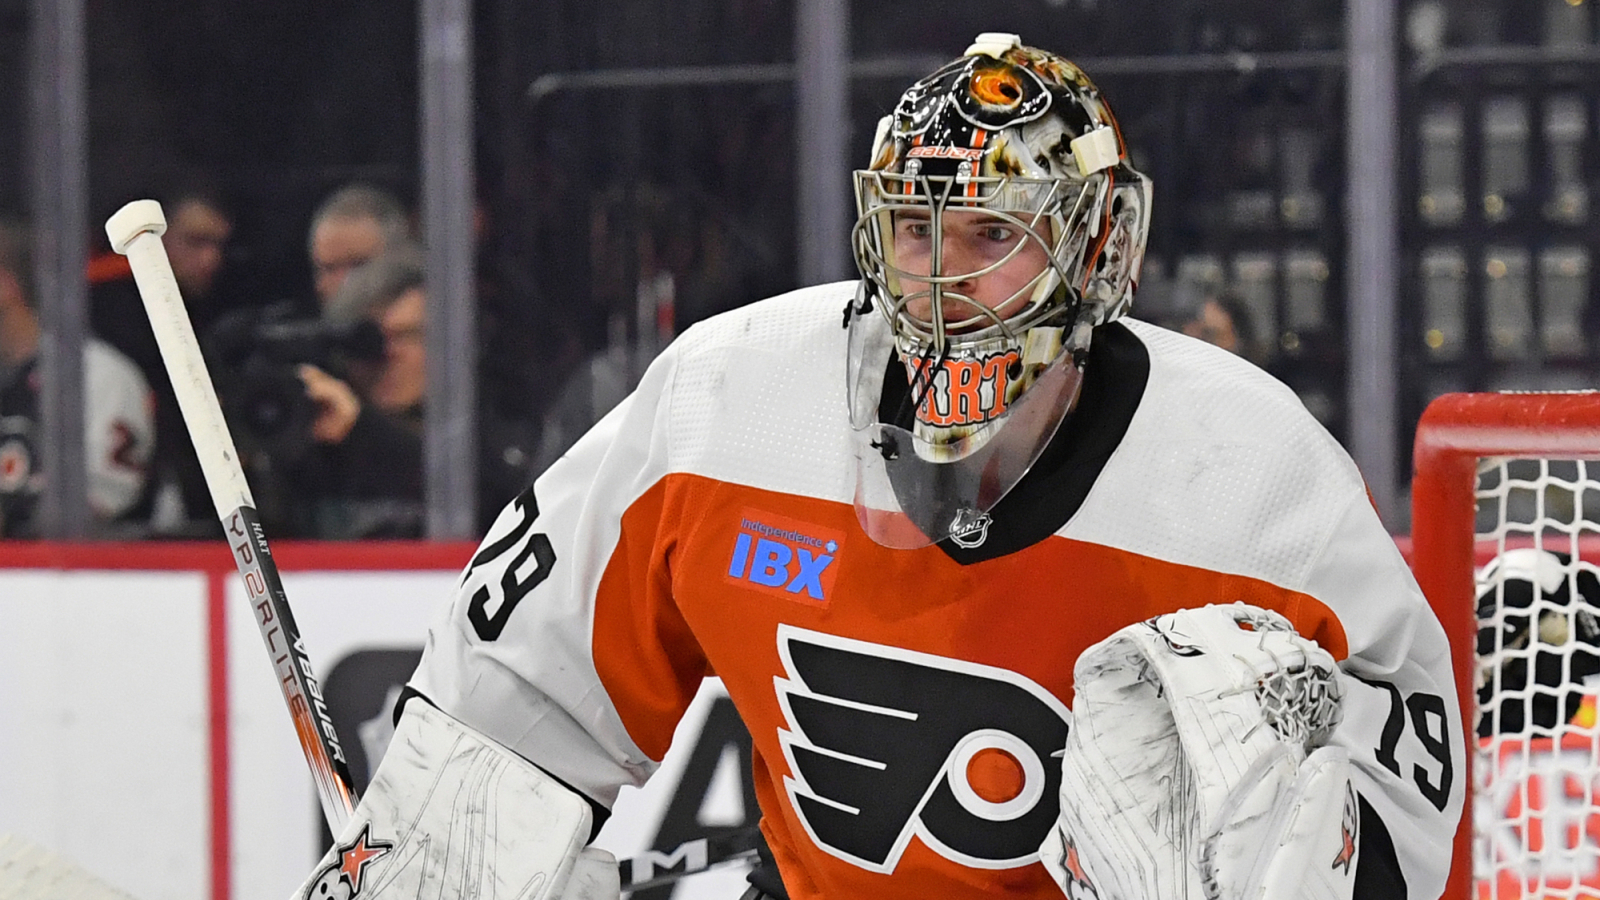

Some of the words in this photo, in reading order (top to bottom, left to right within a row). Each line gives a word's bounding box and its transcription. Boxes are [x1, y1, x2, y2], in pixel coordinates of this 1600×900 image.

[906, 146, 982, 161] BAUER
[251, 521, 271, 556] HART
[741, 517, 823, 548] Independence
[728, 532, 835, 601] IBX
[229, 513, 308, 718] YP2RLITE
[298, 656, 347, 764] BAUER
